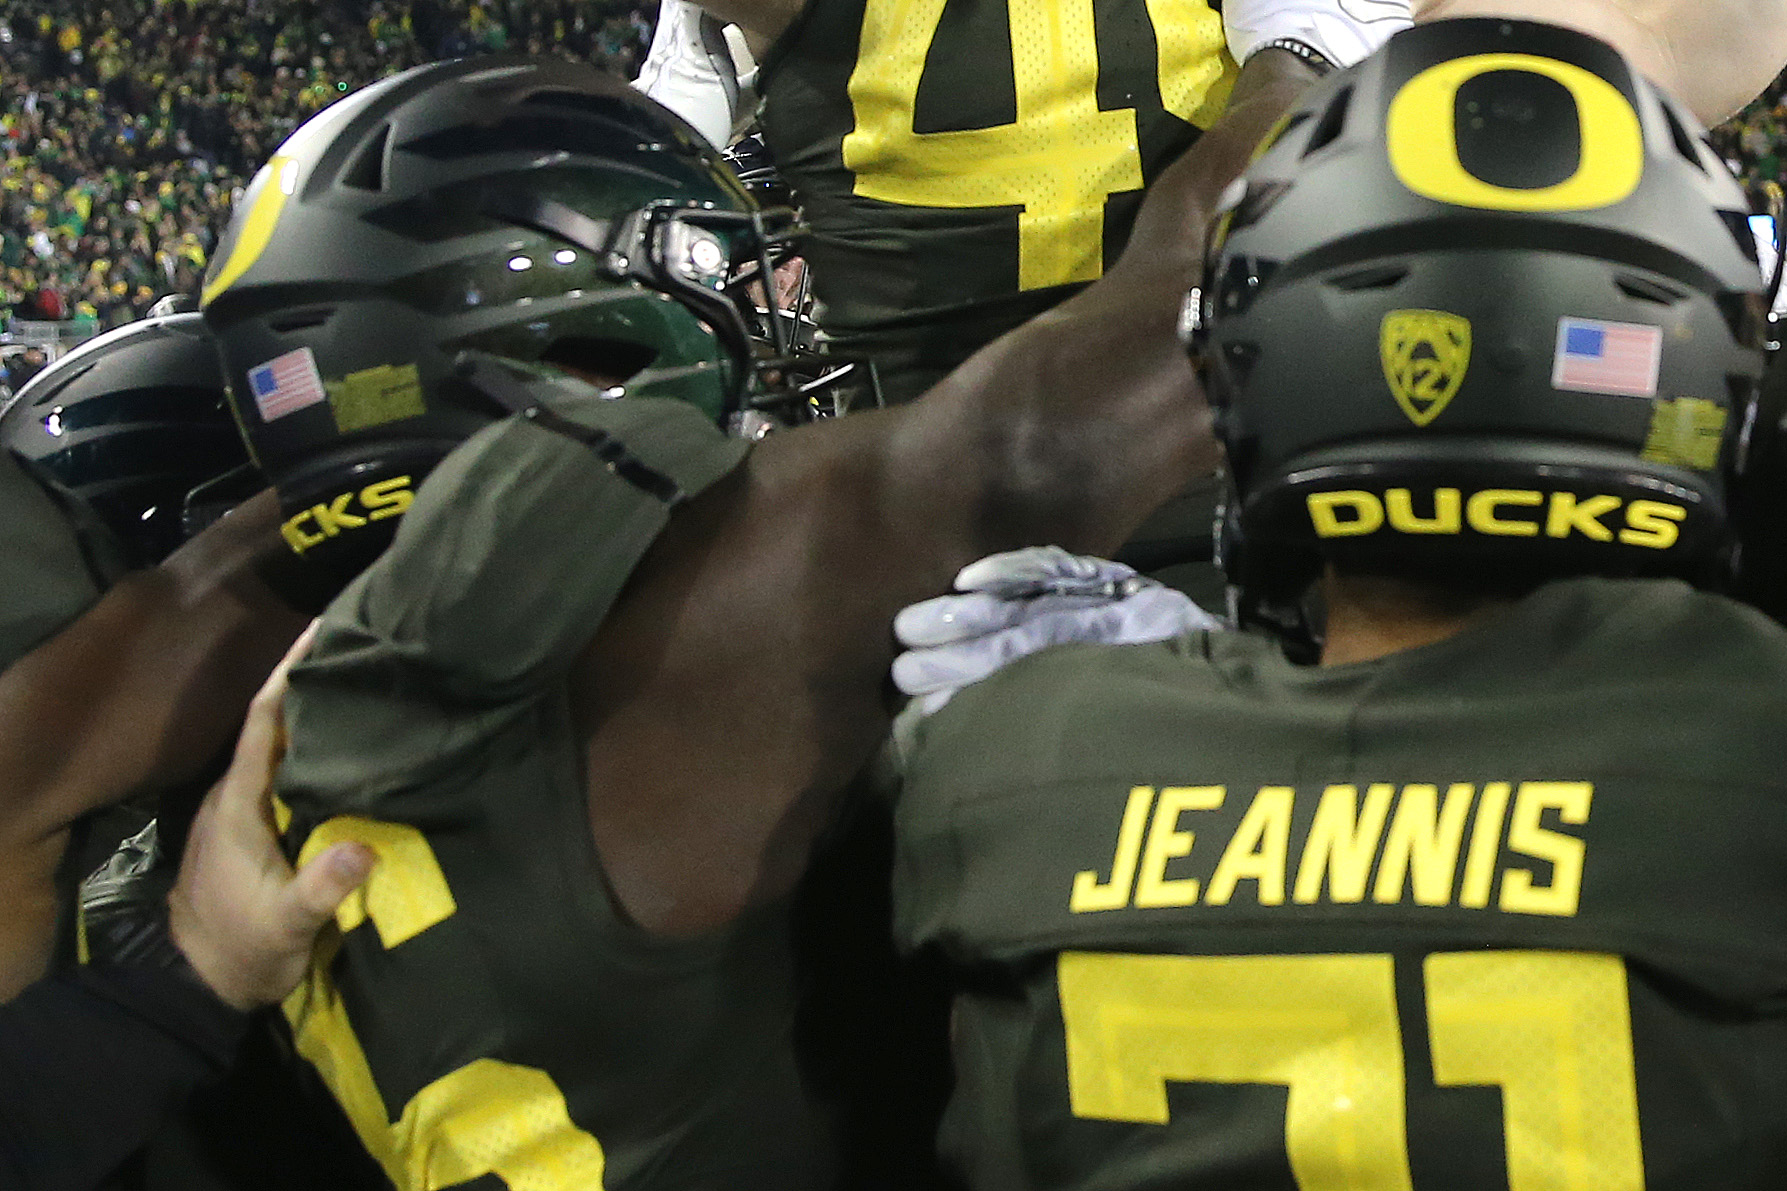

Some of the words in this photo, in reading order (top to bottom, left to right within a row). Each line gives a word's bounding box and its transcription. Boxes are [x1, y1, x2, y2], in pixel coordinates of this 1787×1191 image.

[1387, 52, 1645, 212] O
[1307, 487, 1687, 549] DUCKS
[1069, 780, 1595, 917] JEANNIS
